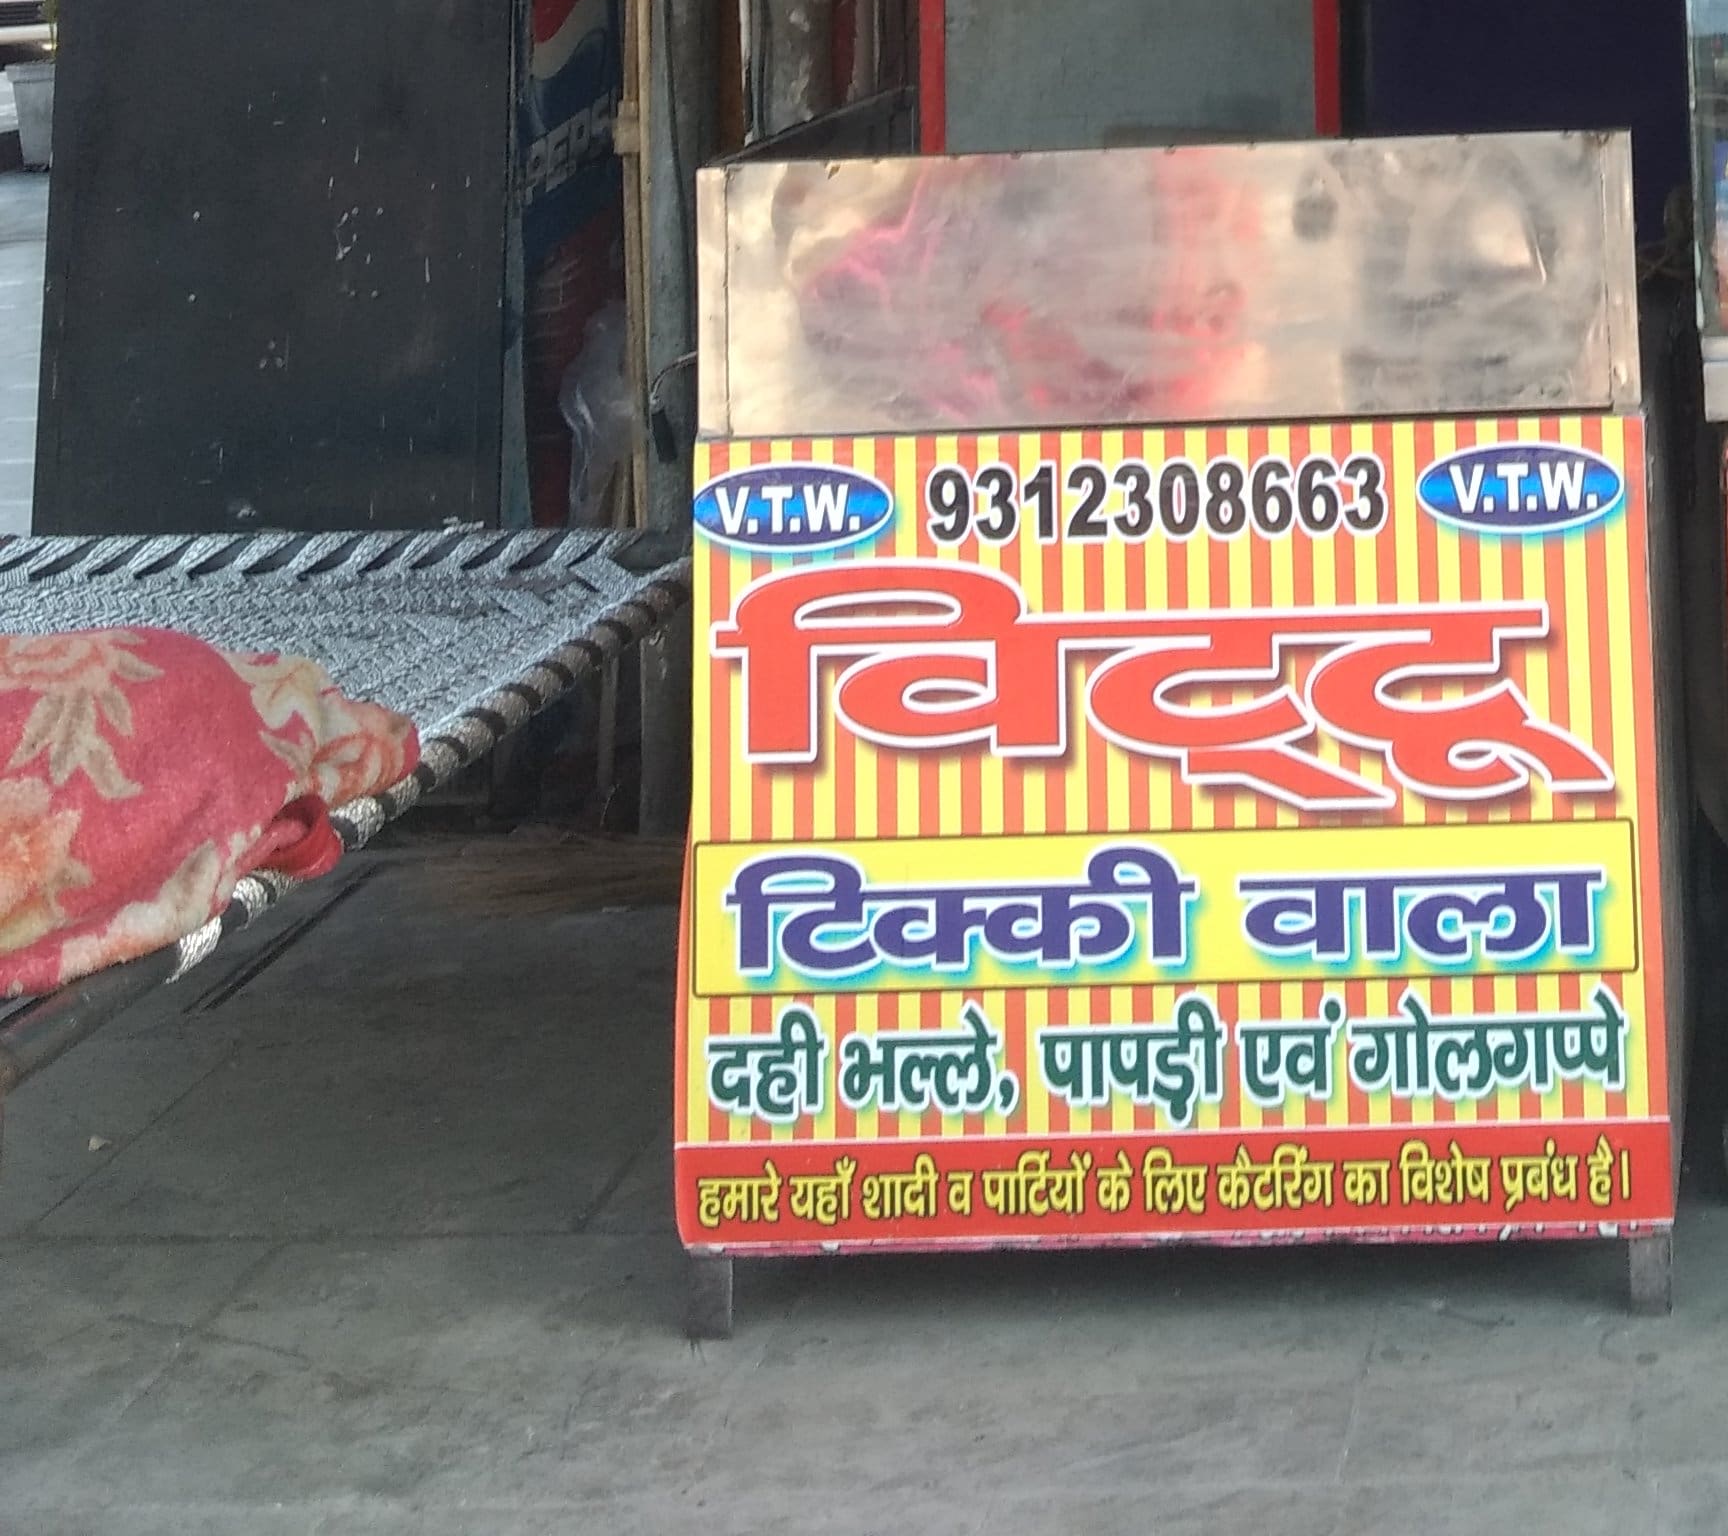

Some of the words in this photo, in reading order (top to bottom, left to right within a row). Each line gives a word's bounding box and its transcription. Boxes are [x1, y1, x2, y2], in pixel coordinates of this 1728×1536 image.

[715, 481, 862, 534] V.T.W.
[928, 457, 1385, 542] 9312308663
[1450, 460, 1599, 513] V.T.W.
[725, 849, 1196, 975] टिक्की
[1239, 867, 1602, 959] वाला
[706, 1008, 824, 1116] दही
[842, 1004, 1017, 1110] भल्ले,
[1039, 998, 1224, 1120] पापड़ी
[1237, 998, 1343, 1099] एवं
[1351, 988, 1624, 1093] गोलगप्पे
[697, 1160, 781, 1226] हमारे
[862, 1153, 939, 1218] शादी
[946, 1171, 972, 1216] व
[1097, 1151, 1133, 1213] के
[1142, 1145, 1208, 1214] लिए
[1343, 1160, 1390, 1205] का
[1400, 1139, 1491, 1205] विशेष
